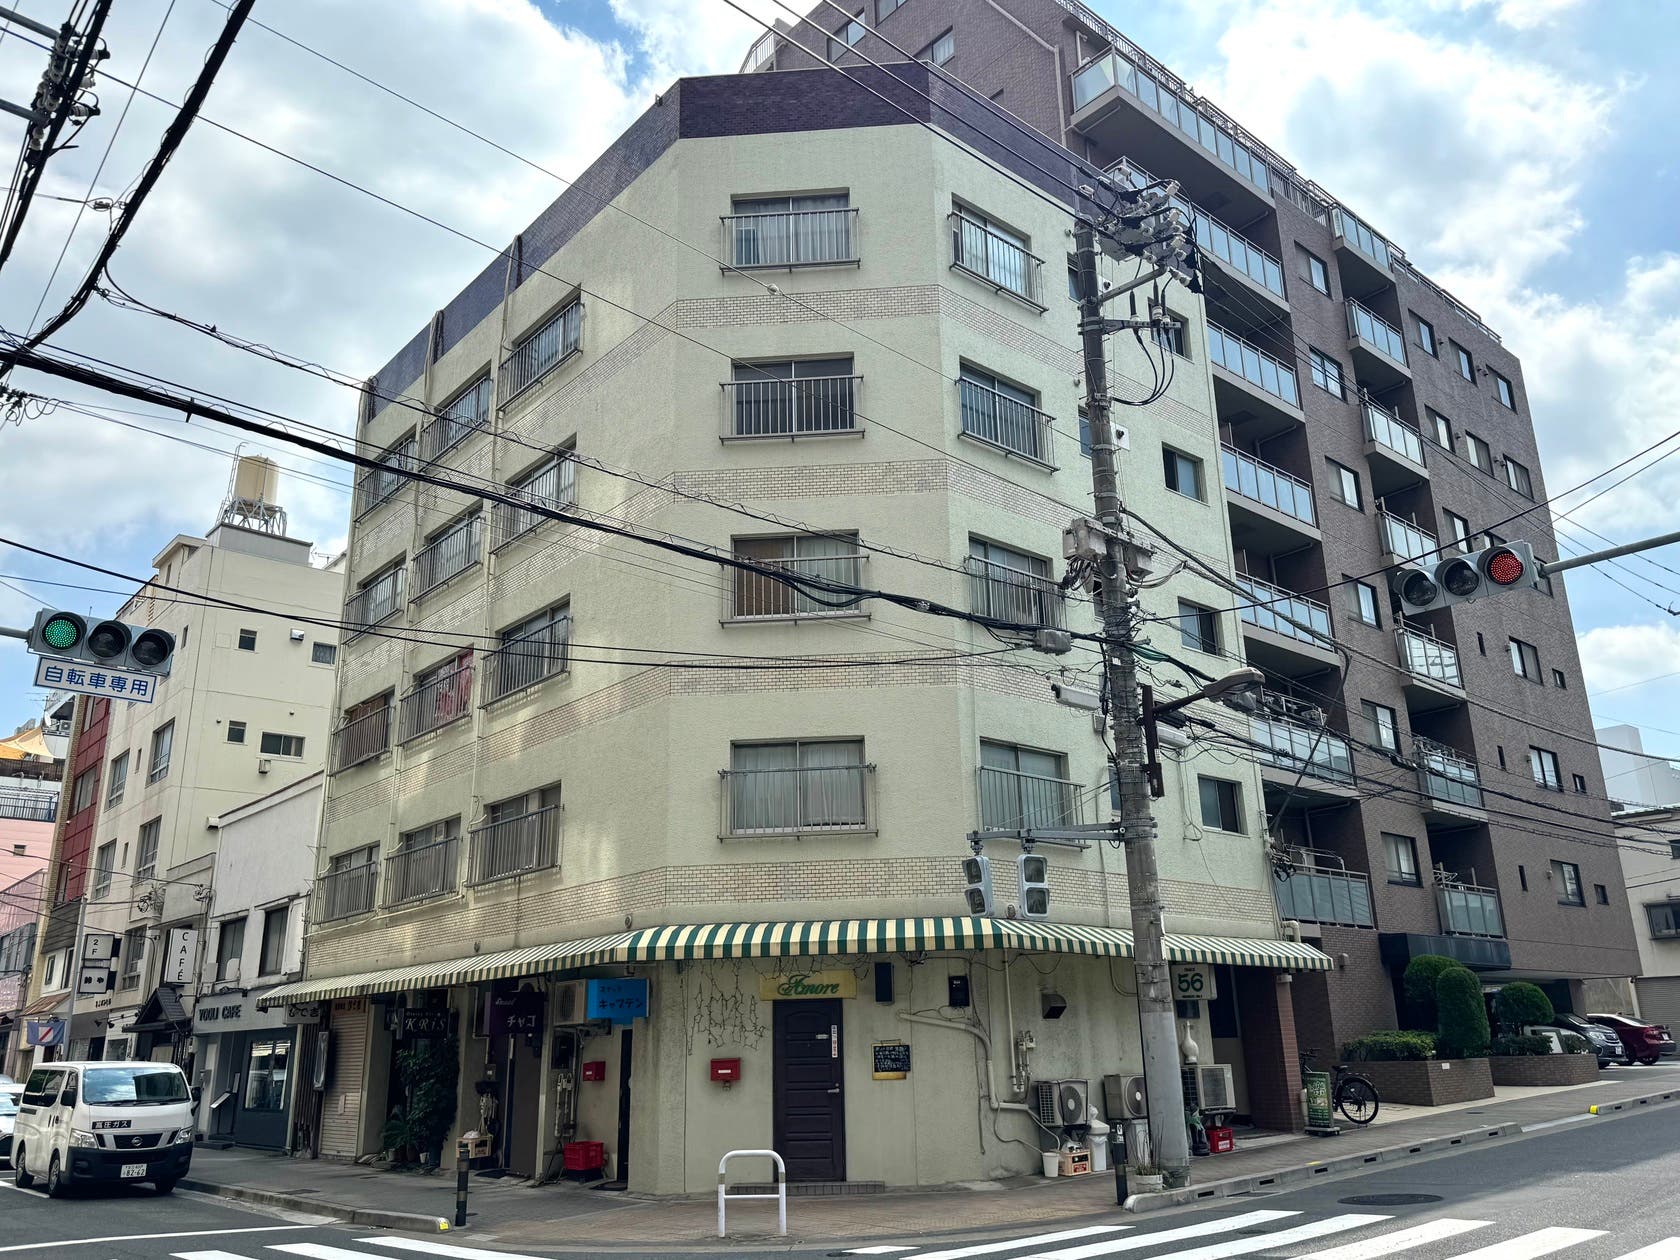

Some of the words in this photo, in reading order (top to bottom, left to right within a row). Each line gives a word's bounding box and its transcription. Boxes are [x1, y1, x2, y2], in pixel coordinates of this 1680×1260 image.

[44, 665, 149, 696] 自転車専用
[177, 931, 189, 981] CAFÉ
[777, 974, 840, 996] Amore
[1178, 972, 1204, 993] 56
[222, 1004, 242, 1020] CAFE
[95, 1120, 129, 1129] 高圧ガス
